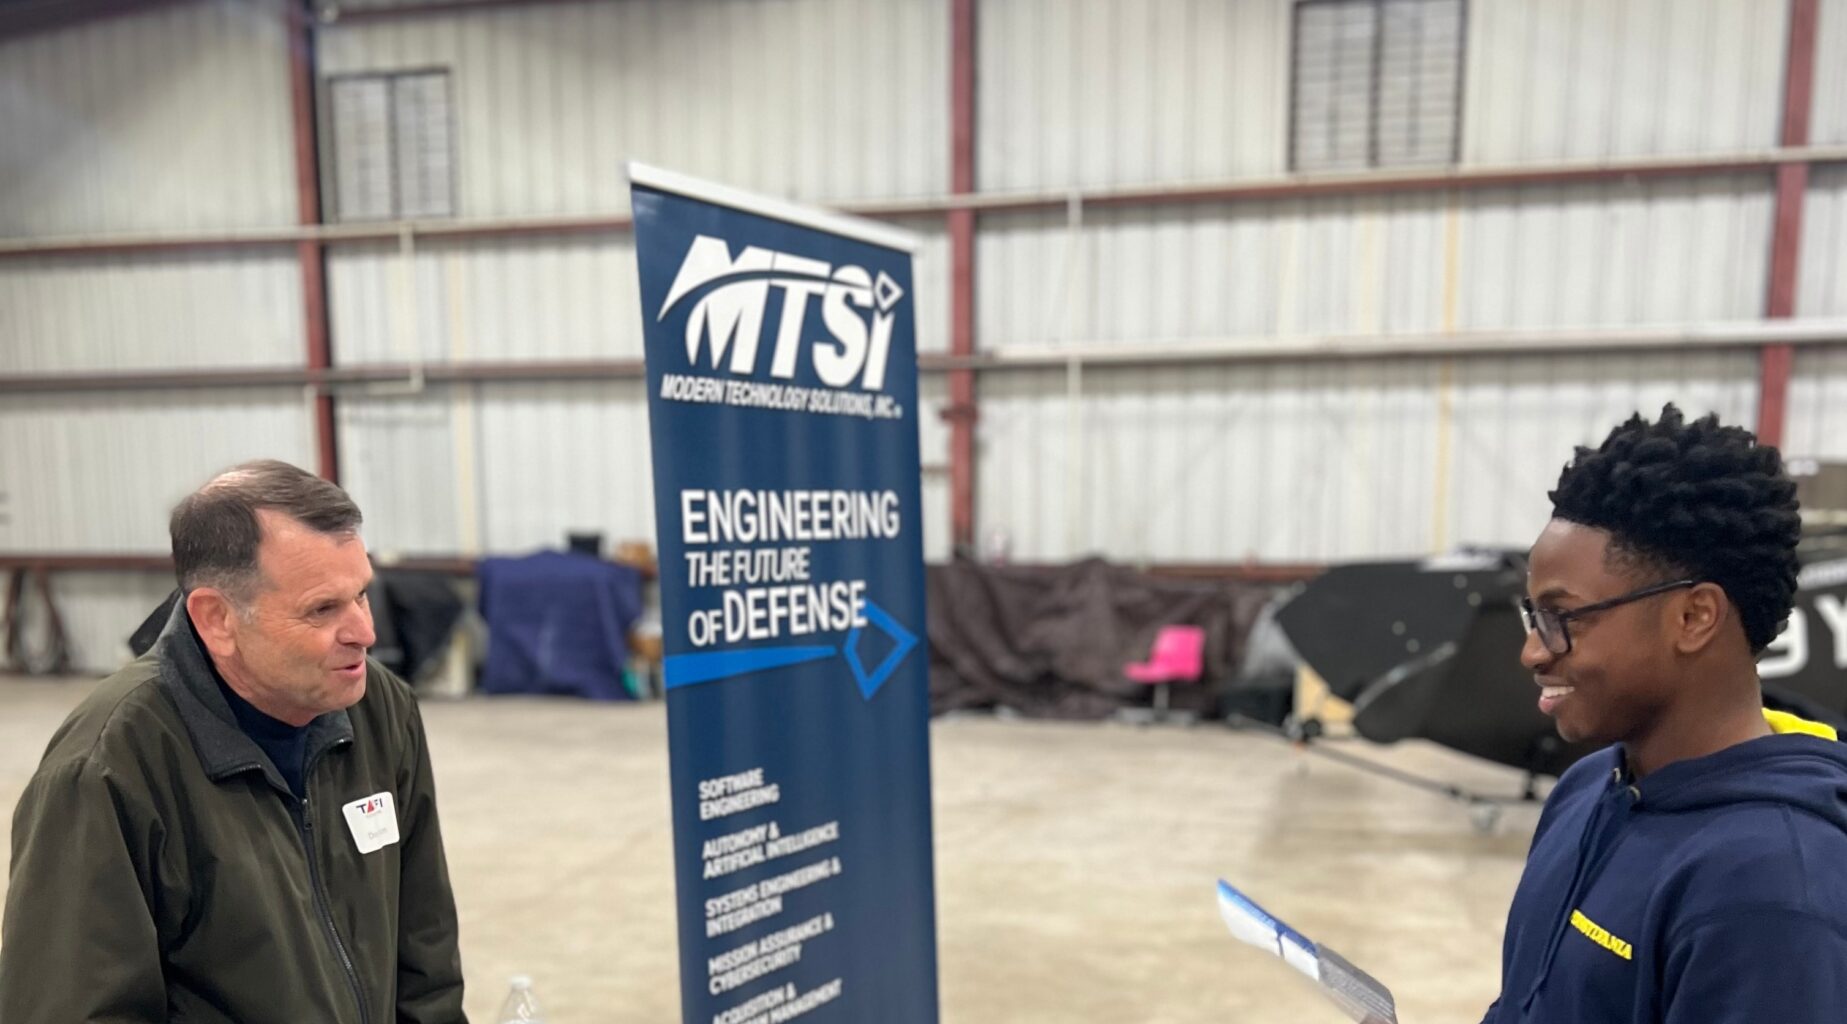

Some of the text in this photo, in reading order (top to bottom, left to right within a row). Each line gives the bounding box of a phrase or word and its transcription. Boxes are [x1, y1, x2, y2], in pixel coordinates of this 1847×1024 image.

[660, 373, 723, 404] MODERN
[724, 379, 808, 411] TECHNOLOGY
[807, 386, 874, 420] SOLUTIONS,
[681, 488, 901, 544] ENGINEERING
[685, 547, 811, 587] THE FUTURE
[688, 580, 868, 648] OF DEFENSE
[697, 766, 765, 801] SOFTWARE
[698, 783, 780, 821] ENGINEERING
[702, 821, 780, 859] AUTONOMY &
[702, 821, 840, 881] ARTIFICIAL INTELLIGENCE
[704, 857, 841, 919] SYSTEMS ENGINEERING &
[705, 895, 782, 939] INTEGRATION
[707, 912, 833, 978] MISSION ASSURANCE &
[708, 943, 803, 996] CYBERSECURITY
[786, 982, 797, 1001] &
